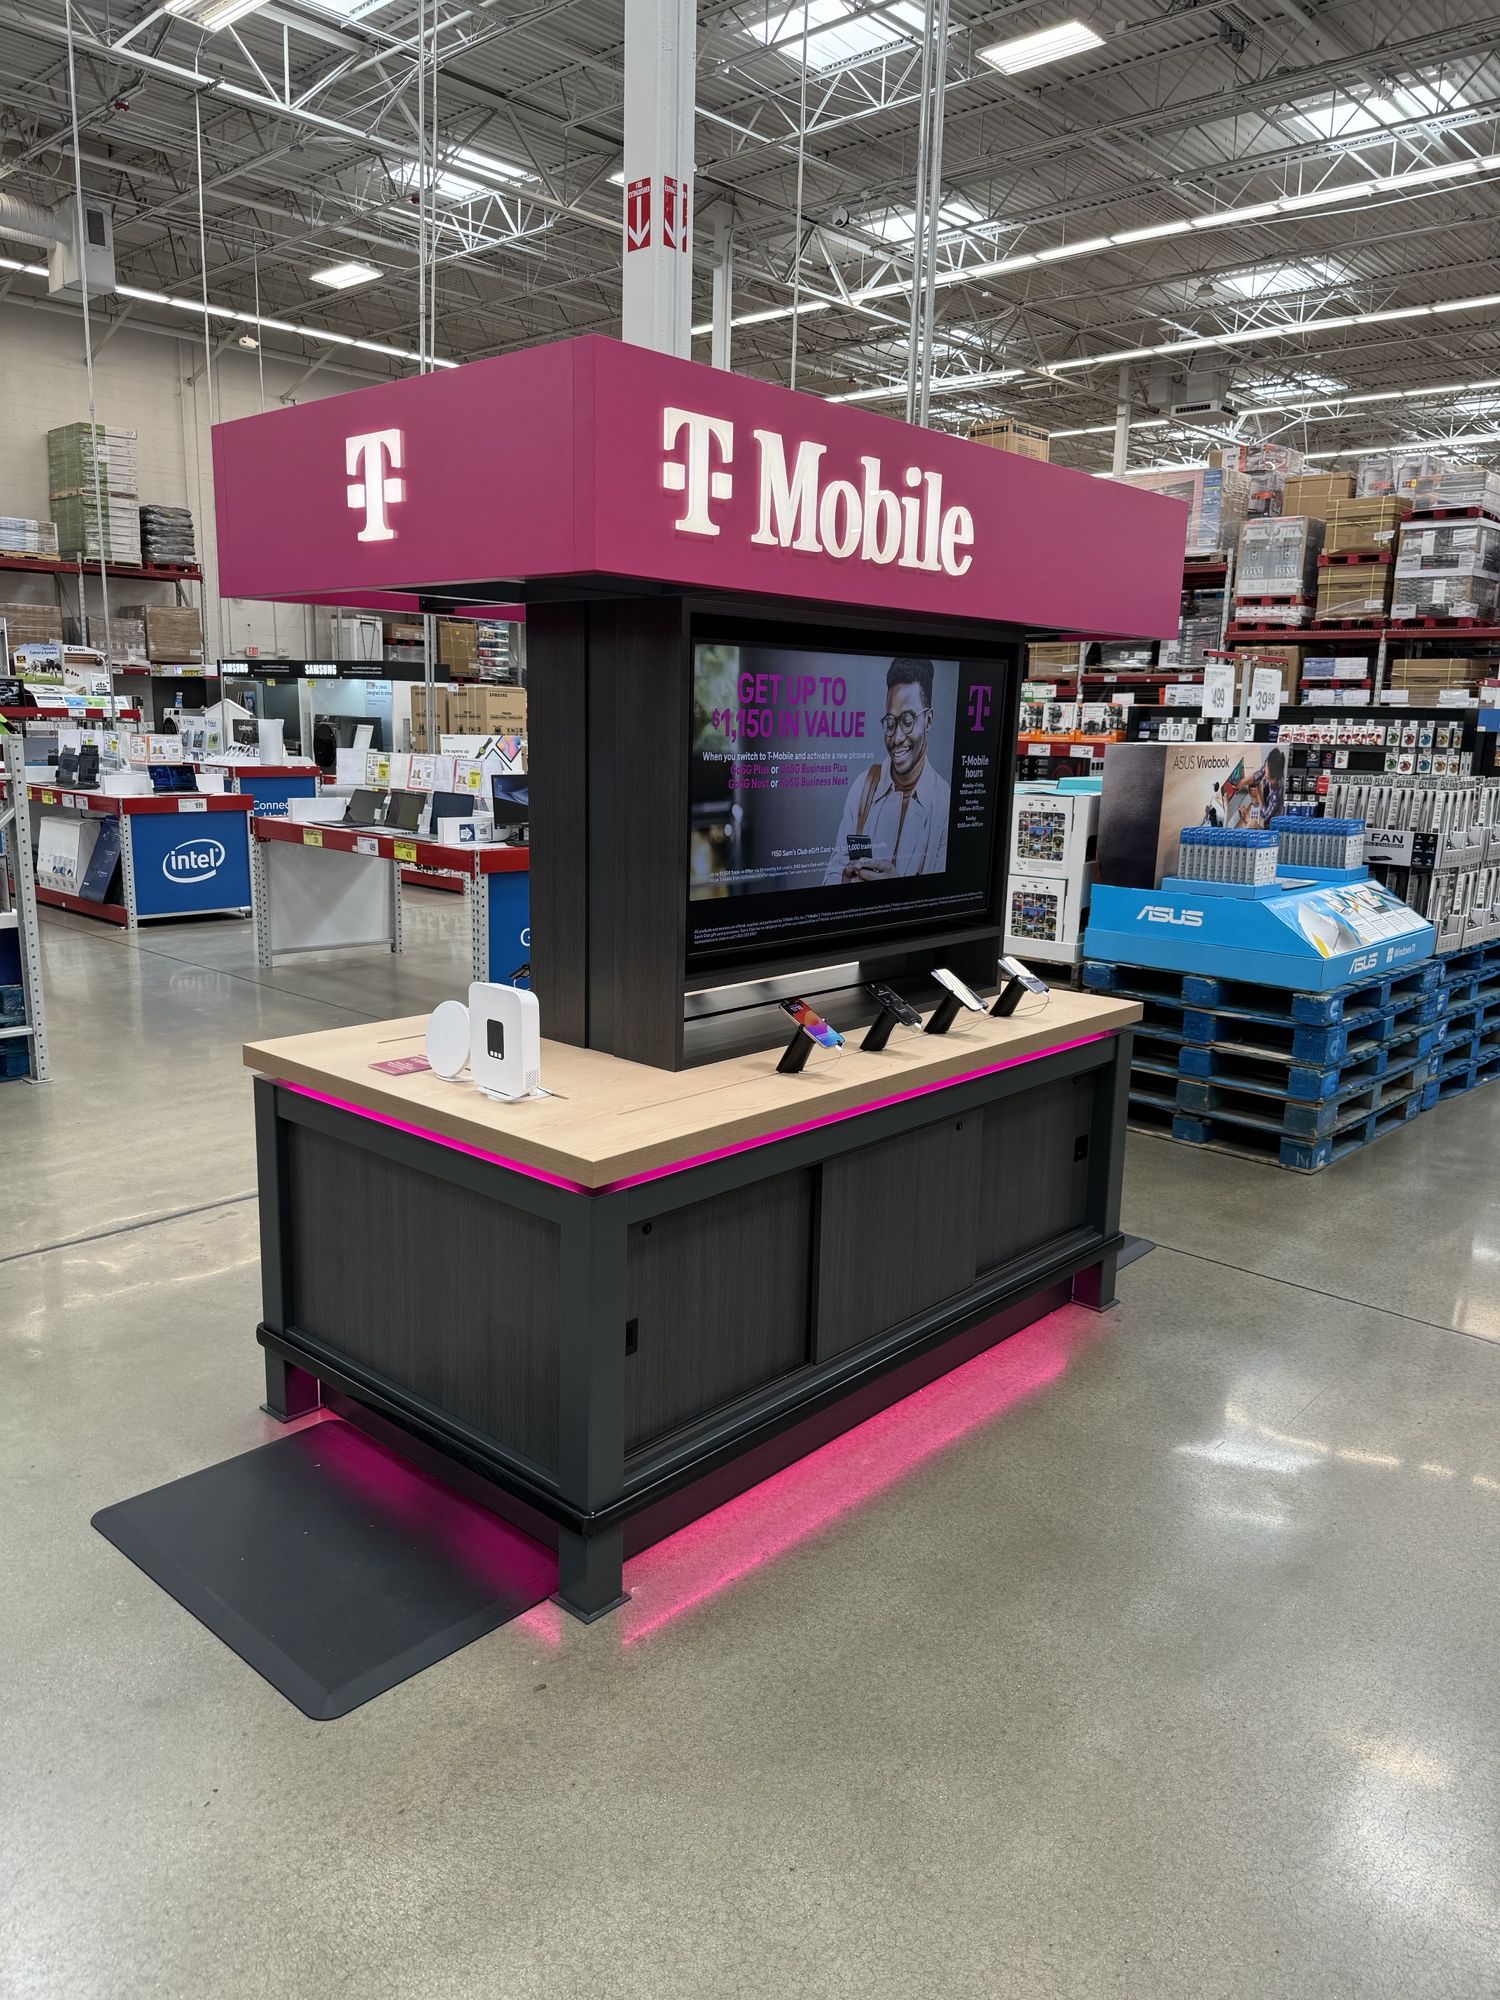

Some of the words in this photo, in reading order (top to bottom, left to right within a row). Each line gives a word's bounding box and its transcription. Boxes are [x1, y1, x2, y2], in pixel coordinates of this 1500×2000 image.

[345, 428, 406, 542] T
[751, 429, 975, 577] Mobile
[305, 664, 337, 676] SAMSUNG
[737, 672, 783, 705] GET
[786, 675, 818, 706] UP
[820, 677, 847, 707] TO
[711, 708, 774, 743] $1,150
[778, 710, 800, 738] IN
[804, 710, 866, 738] VALUE
[702, 752, 723, 761] When
[723, 753, 736, 763] you
[737, 752, 758, 761] switch
[759, 753, 766, 761] to
[767, 751, 793, 761] T-Mobile
[794, 752, 806, 760] and
[807, 751, 831, 760] activate
[836, 752, 848, 760] new
[849, 752, 866, 761] phone
[961, 755, 989, 766] T-Mobile
[1173, 755, 1196, 770] ASUS
[1196, 754, 1230, 769] Vivobook
[752, 764, 770, 774] Plus
[770, 765, 779, 774] or
[801, 763, 832, 774] Business
[832, 762, 848, 773] Plus
[965, 767, 983, 778] hours
[751, 778, 769, 789] Next
[770, 779, 778, 788] or
[801, 777, 832, 787] Business
[832, 776, 849, 785] Next
[254, 800, 289, 811] Connec
[1371, 833, 1404, 844] FAN
[782, 848, 797, 857] Sam's
[797, 848, 808, 856] Club
[820, 846, 832, 854] Card
[1136, 905, 1204, 927] ASUS
[1348, 952, 1379, 975] ASUS
[1393, 945, 1412, 958] Windows
